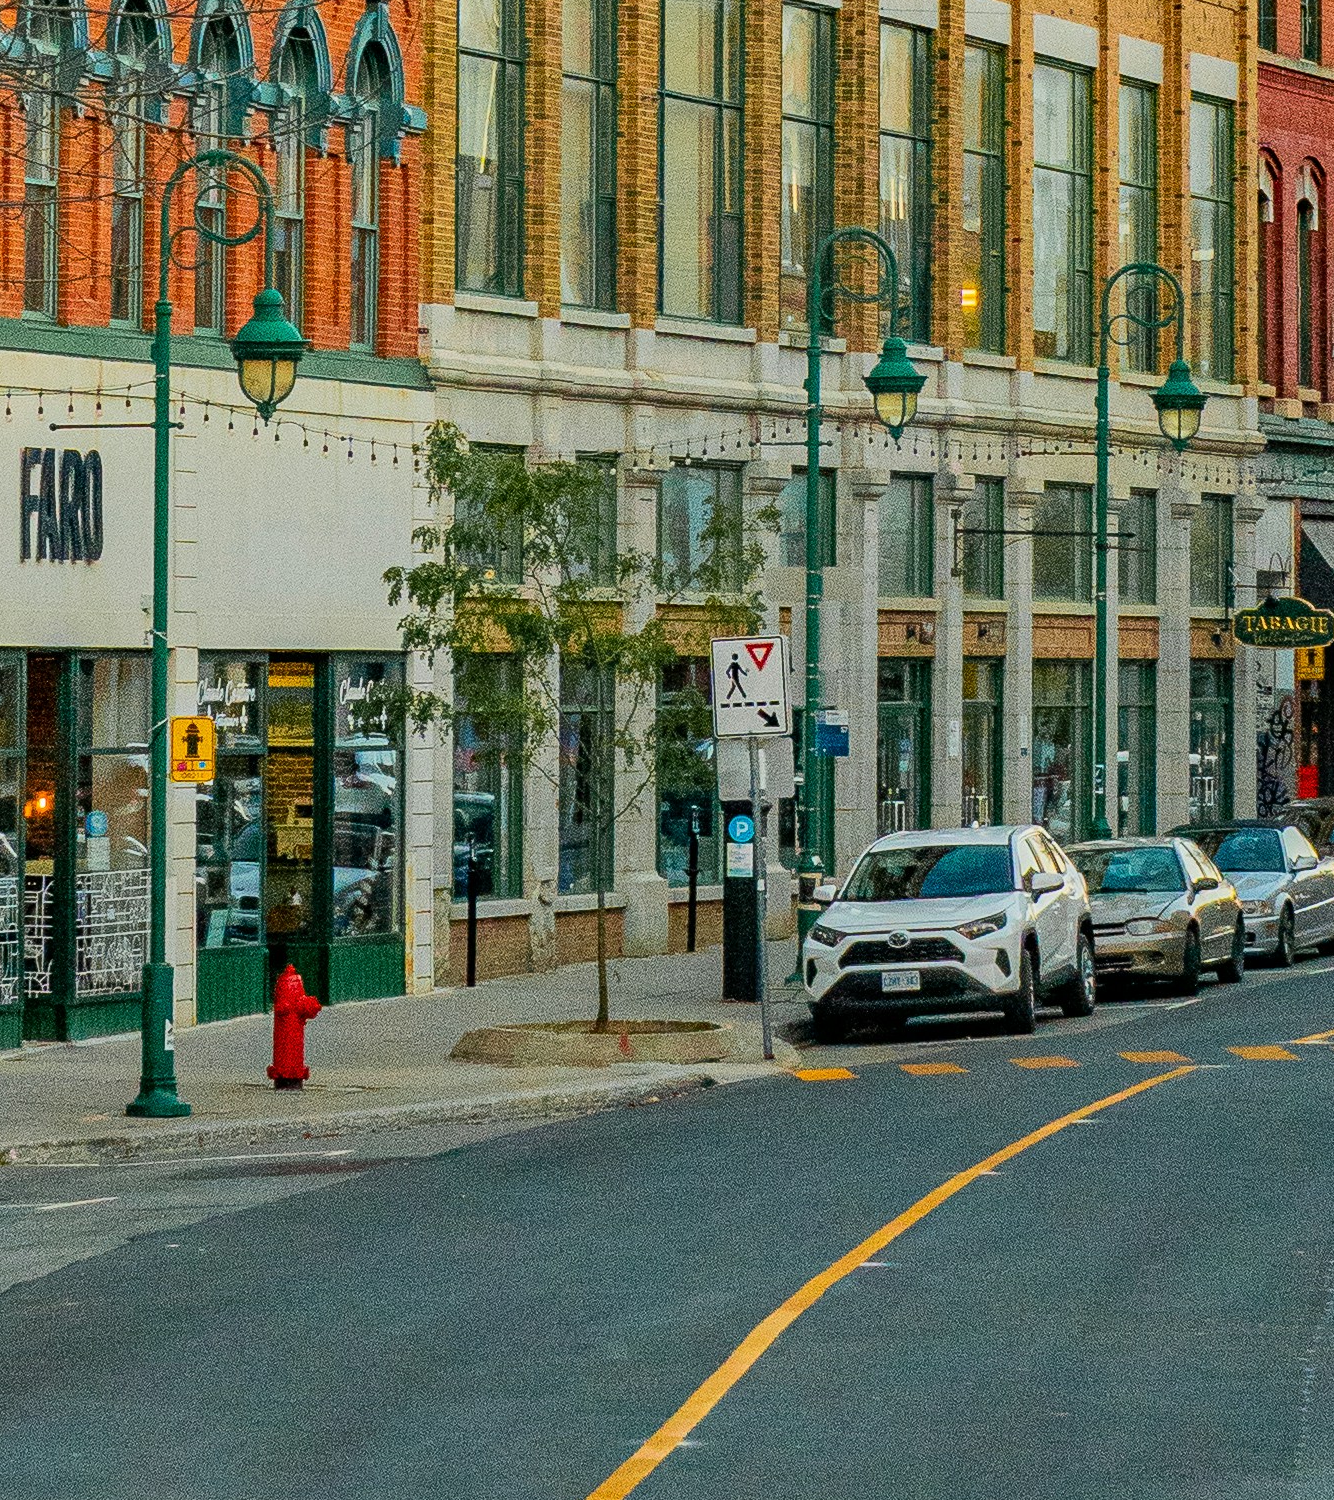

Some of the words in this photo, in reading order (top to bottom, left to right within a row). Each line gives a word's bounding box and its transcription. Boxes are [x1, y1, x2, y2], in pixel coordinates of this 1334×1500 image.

[20, 446, 104, 566] FARO
[1243, 616, 1328, 634] TABAGIE
[736, 821, 749, 837] P
